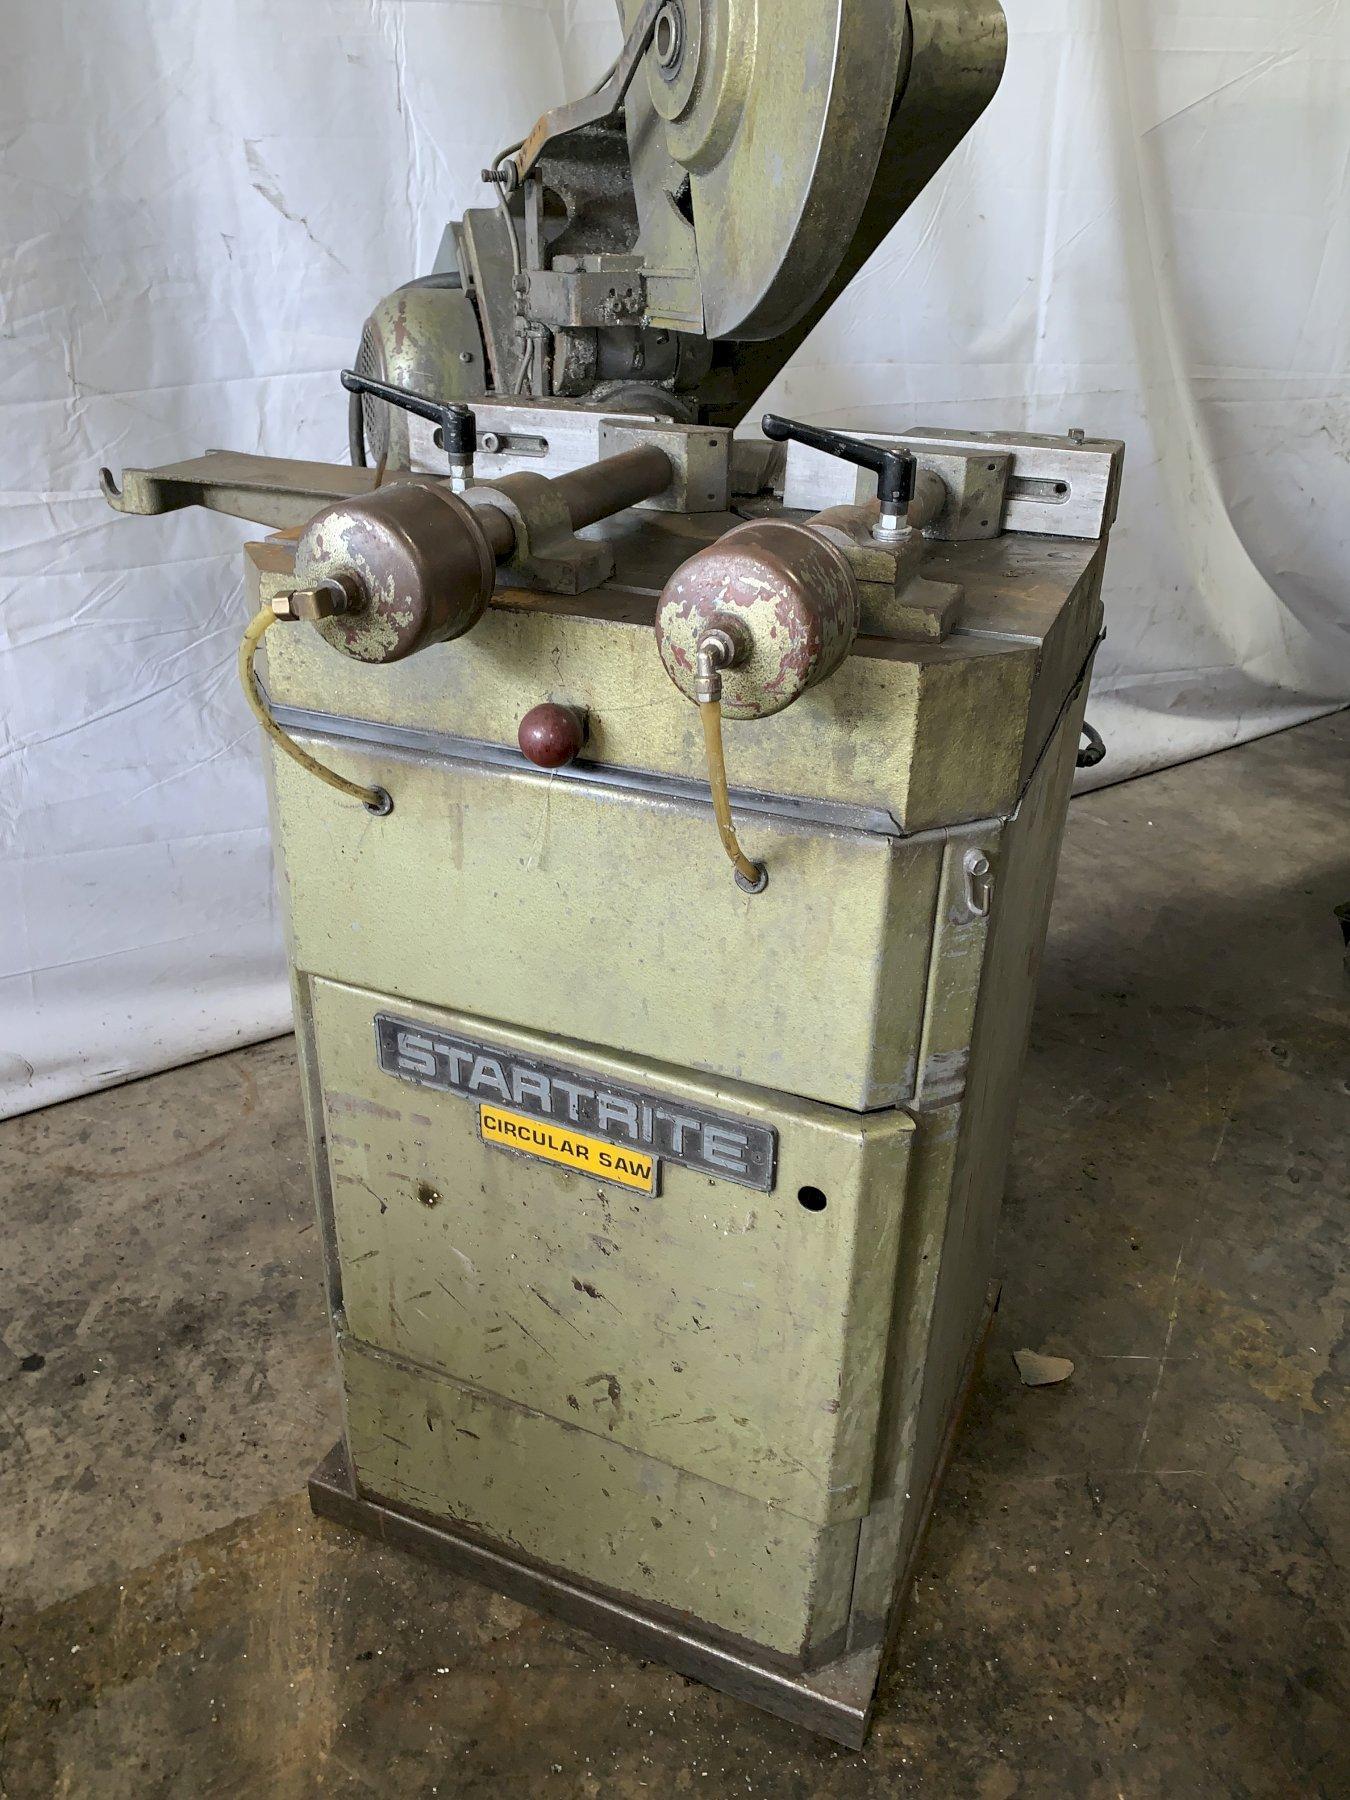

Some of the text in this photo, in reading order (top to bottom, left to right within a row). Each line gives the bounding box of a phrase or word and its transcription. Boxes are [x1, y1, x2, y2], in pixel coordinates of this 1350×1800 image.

[397, 1032, 749, 1174] STARTRITE
[483, 1115, 652, 1180] CIRCULAR SAW
